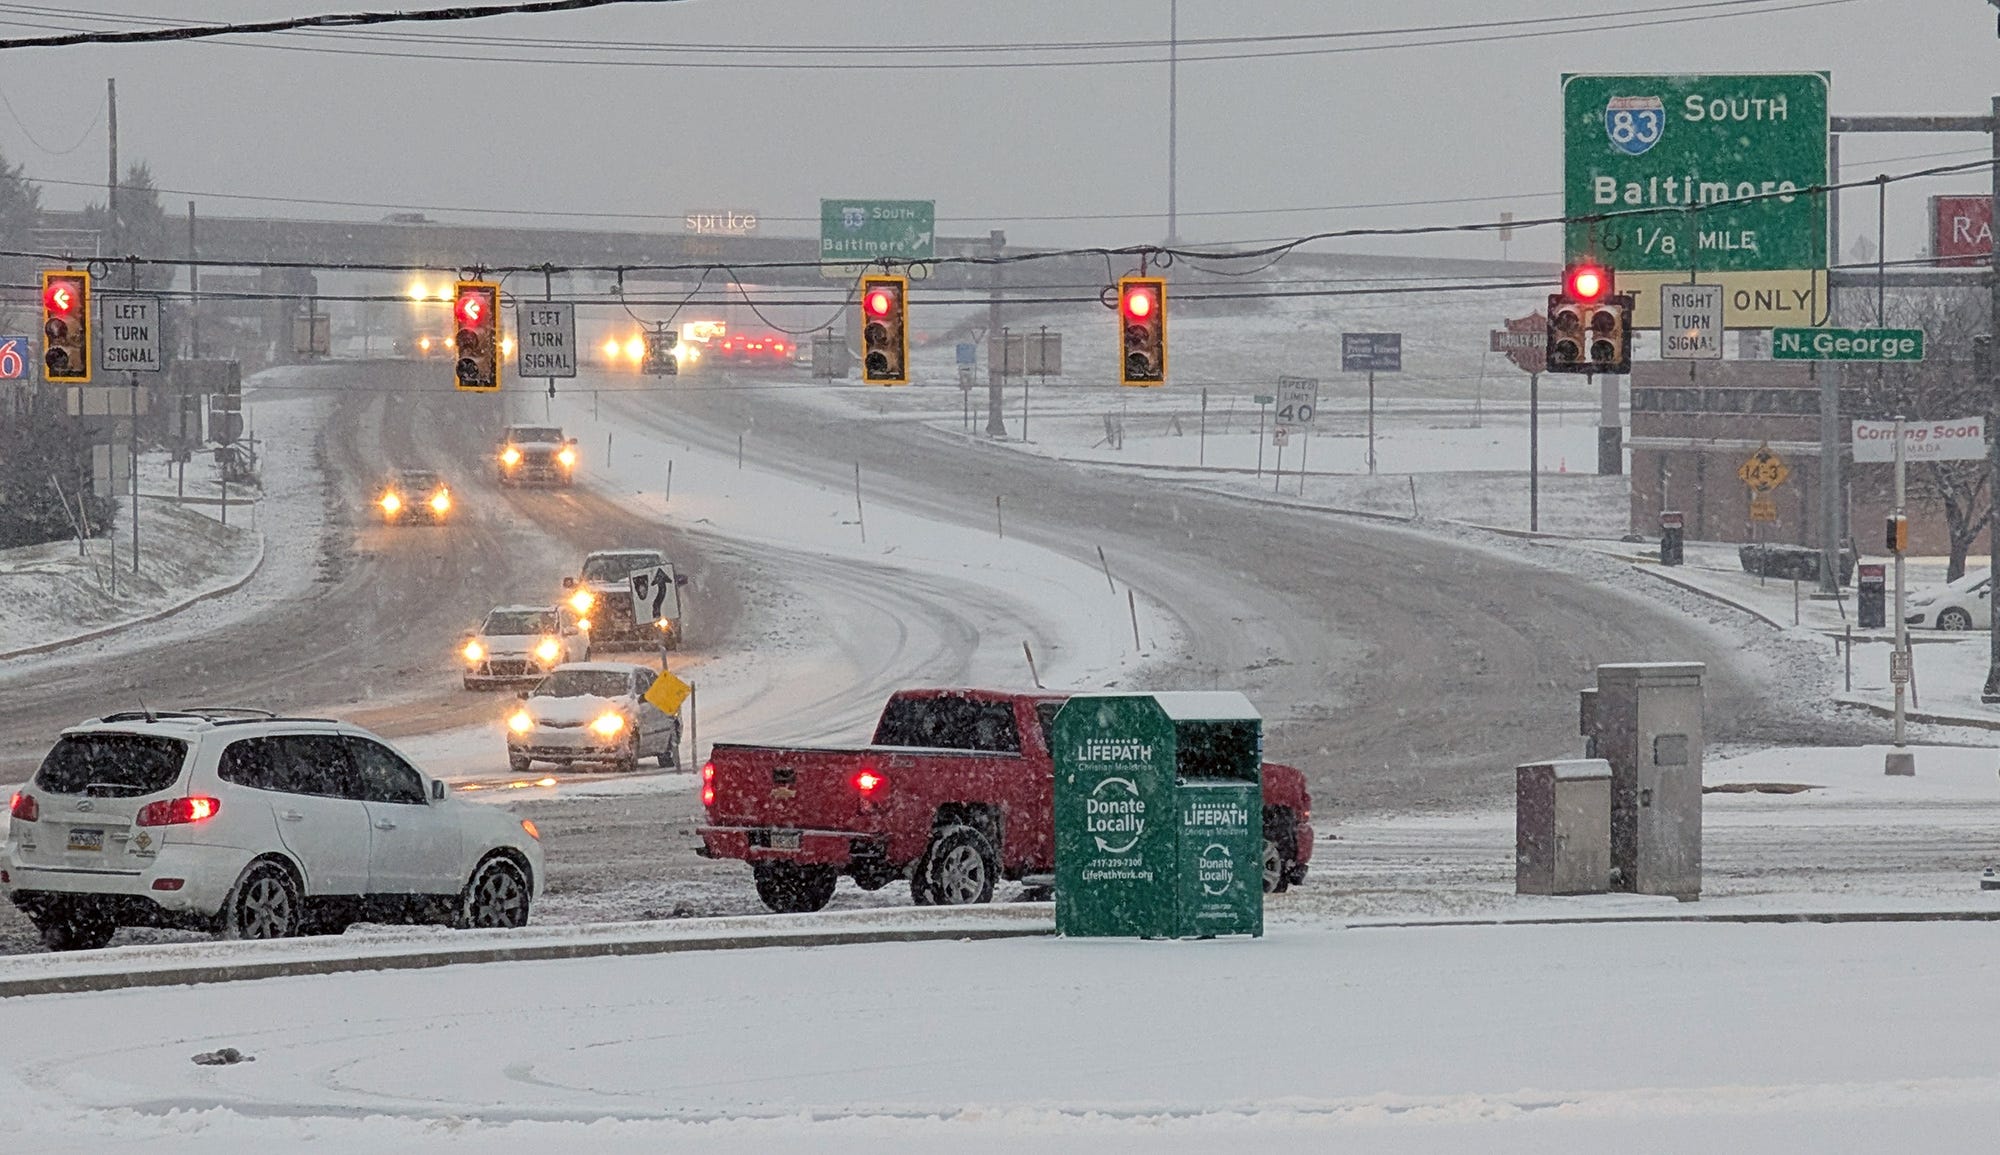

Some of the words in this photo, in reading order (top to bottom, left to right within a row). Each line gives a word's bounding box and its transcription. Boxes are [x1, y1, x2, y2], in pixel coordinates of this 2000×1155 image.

[1612, 110, 1658, 143] 83
[1684, 95, 1788, 121] SOUTH
[1594, 175, 1797, 205] Baltimore
[844, 213, 864, 227] 83
[872, 207, 915, 219] SOUTH
[822, 238, 905, 251] Baltimore
[1636, 228, 1676, 254] 1/8
[1699, 231, 1756, 250] MILE
[1671, 293, 1713, 309] RIGHT
[1734, 289, 1812, 311] ONLY
[115, 304, 147, 319] LEFT
[530, 311, 560, 326] LEFT
[1672, 314, 1711, 330] TURN
[113, 326, 148, 341] TURN
[529, 332, 563, 347] TURN
[1667, 335, 1716, 351] SIGNAL
[1813, 334, 1915, 359] George
[0, 340, 22, 379] 6
[108, 347, 155, 363] SIGNAL
[525, 353, 570, 369] SIGNAL
[1281, 380, 1315, 390] SPEED
[1283, 391, 1309, 402] LIMIT
[1278, 404, 1313, 422] 40
[1856, 425, 1928, 441] Comng
[1932, 425, 1980, 439] Soon
[1889, 443, 1942, 453] RMADA
[1078, 745, 1152, 761] LIFEPATH
[1086, 798, 1146, 814] Donate
[1086, 814, 1146, 836] Locally
[1184, 809, 1248, 825] LIFEPATH
[1199, 858, 1234, 869] Donate
[1199, 869, 1234, 884] Locally
